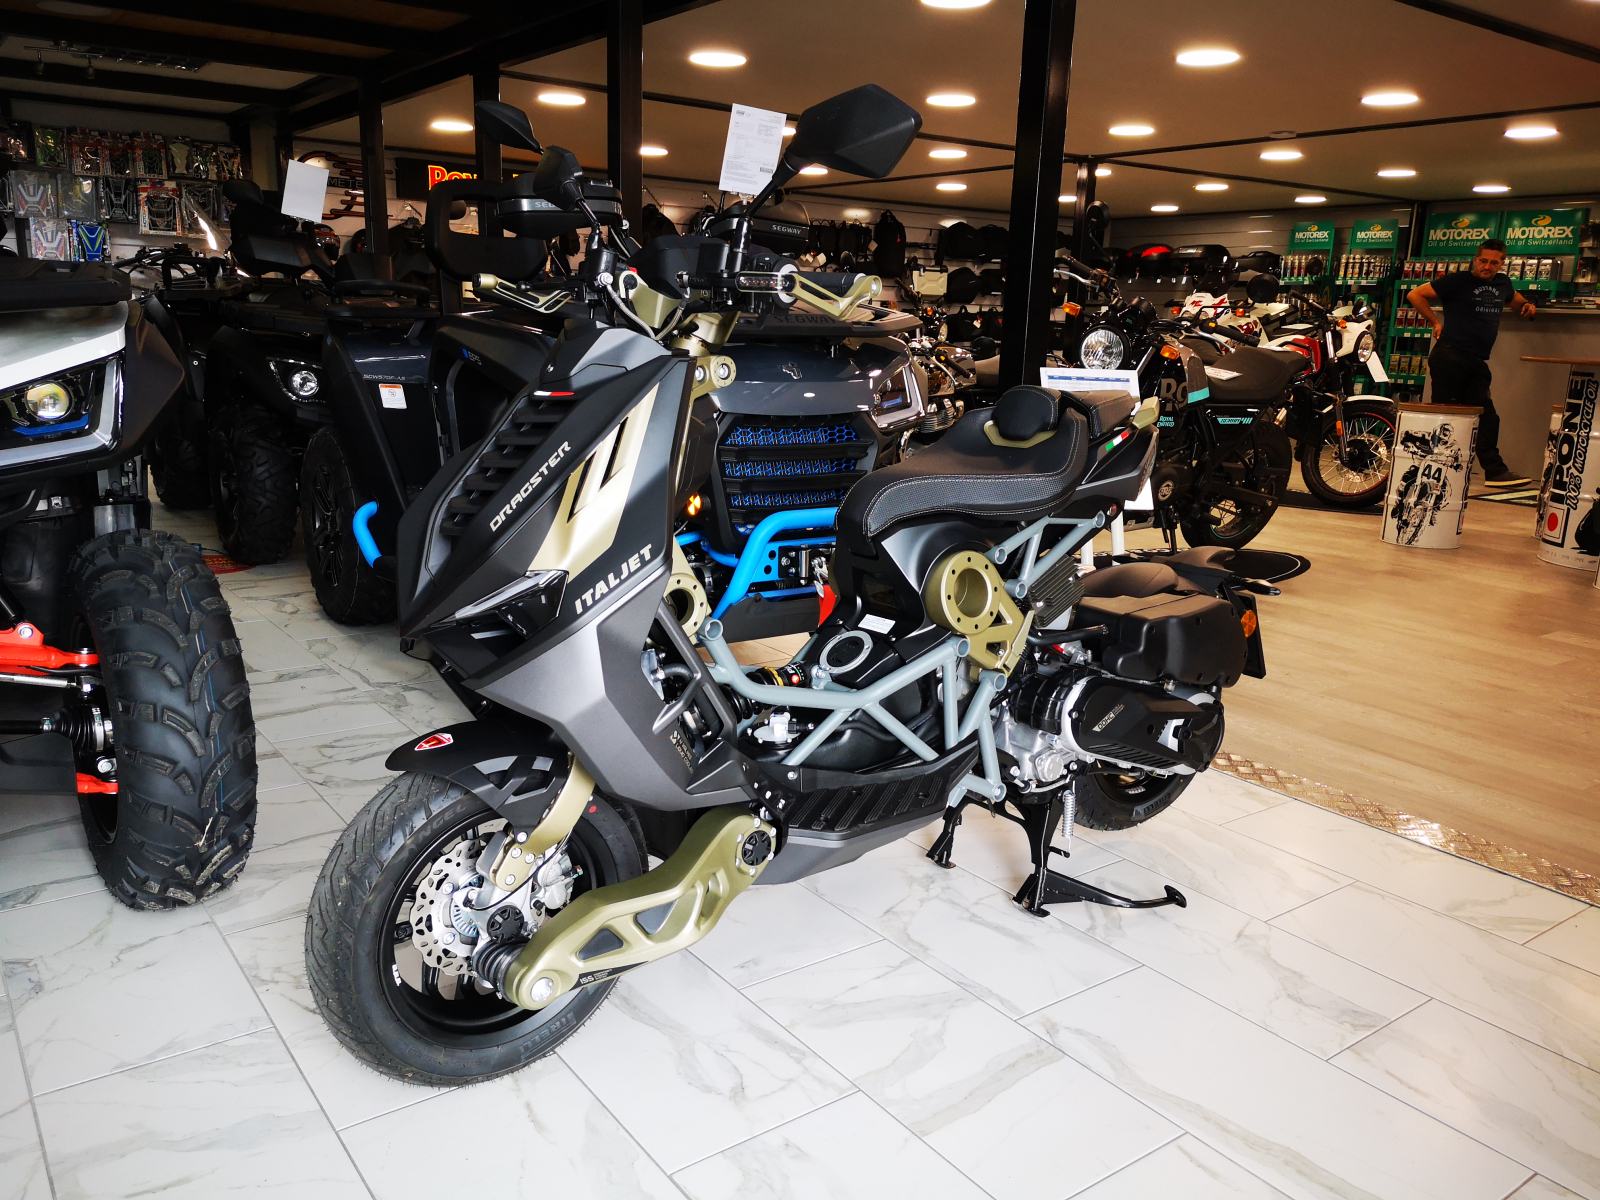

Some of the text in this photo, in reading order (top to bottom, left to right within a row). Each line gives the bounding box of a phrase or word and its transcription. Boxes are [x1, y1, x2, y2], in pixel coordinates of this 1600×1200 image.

[772, 224, 802, 235] SEGWAY
[1295, 231, 1329, 239] MOTOREX
[1356, 231, 1393, 239] MOTOREX
[1428, 228, 1491, 240] MOTOREX
[1507, 226, 1574, 239] MOTOREX
[1528, 238, 1574, 246] Switzerland
[1550, 377, 1586, 505] IPONE
[1566, 379, 1599, 510] 100% MOTORCYCLE OIL
[1421, 463, 1443, 483] 44
[489, 441, 572, 532] DRAGSTER
[574, 544, 652, 615] ITALJET
[580, 975, 595, 985] ISS
